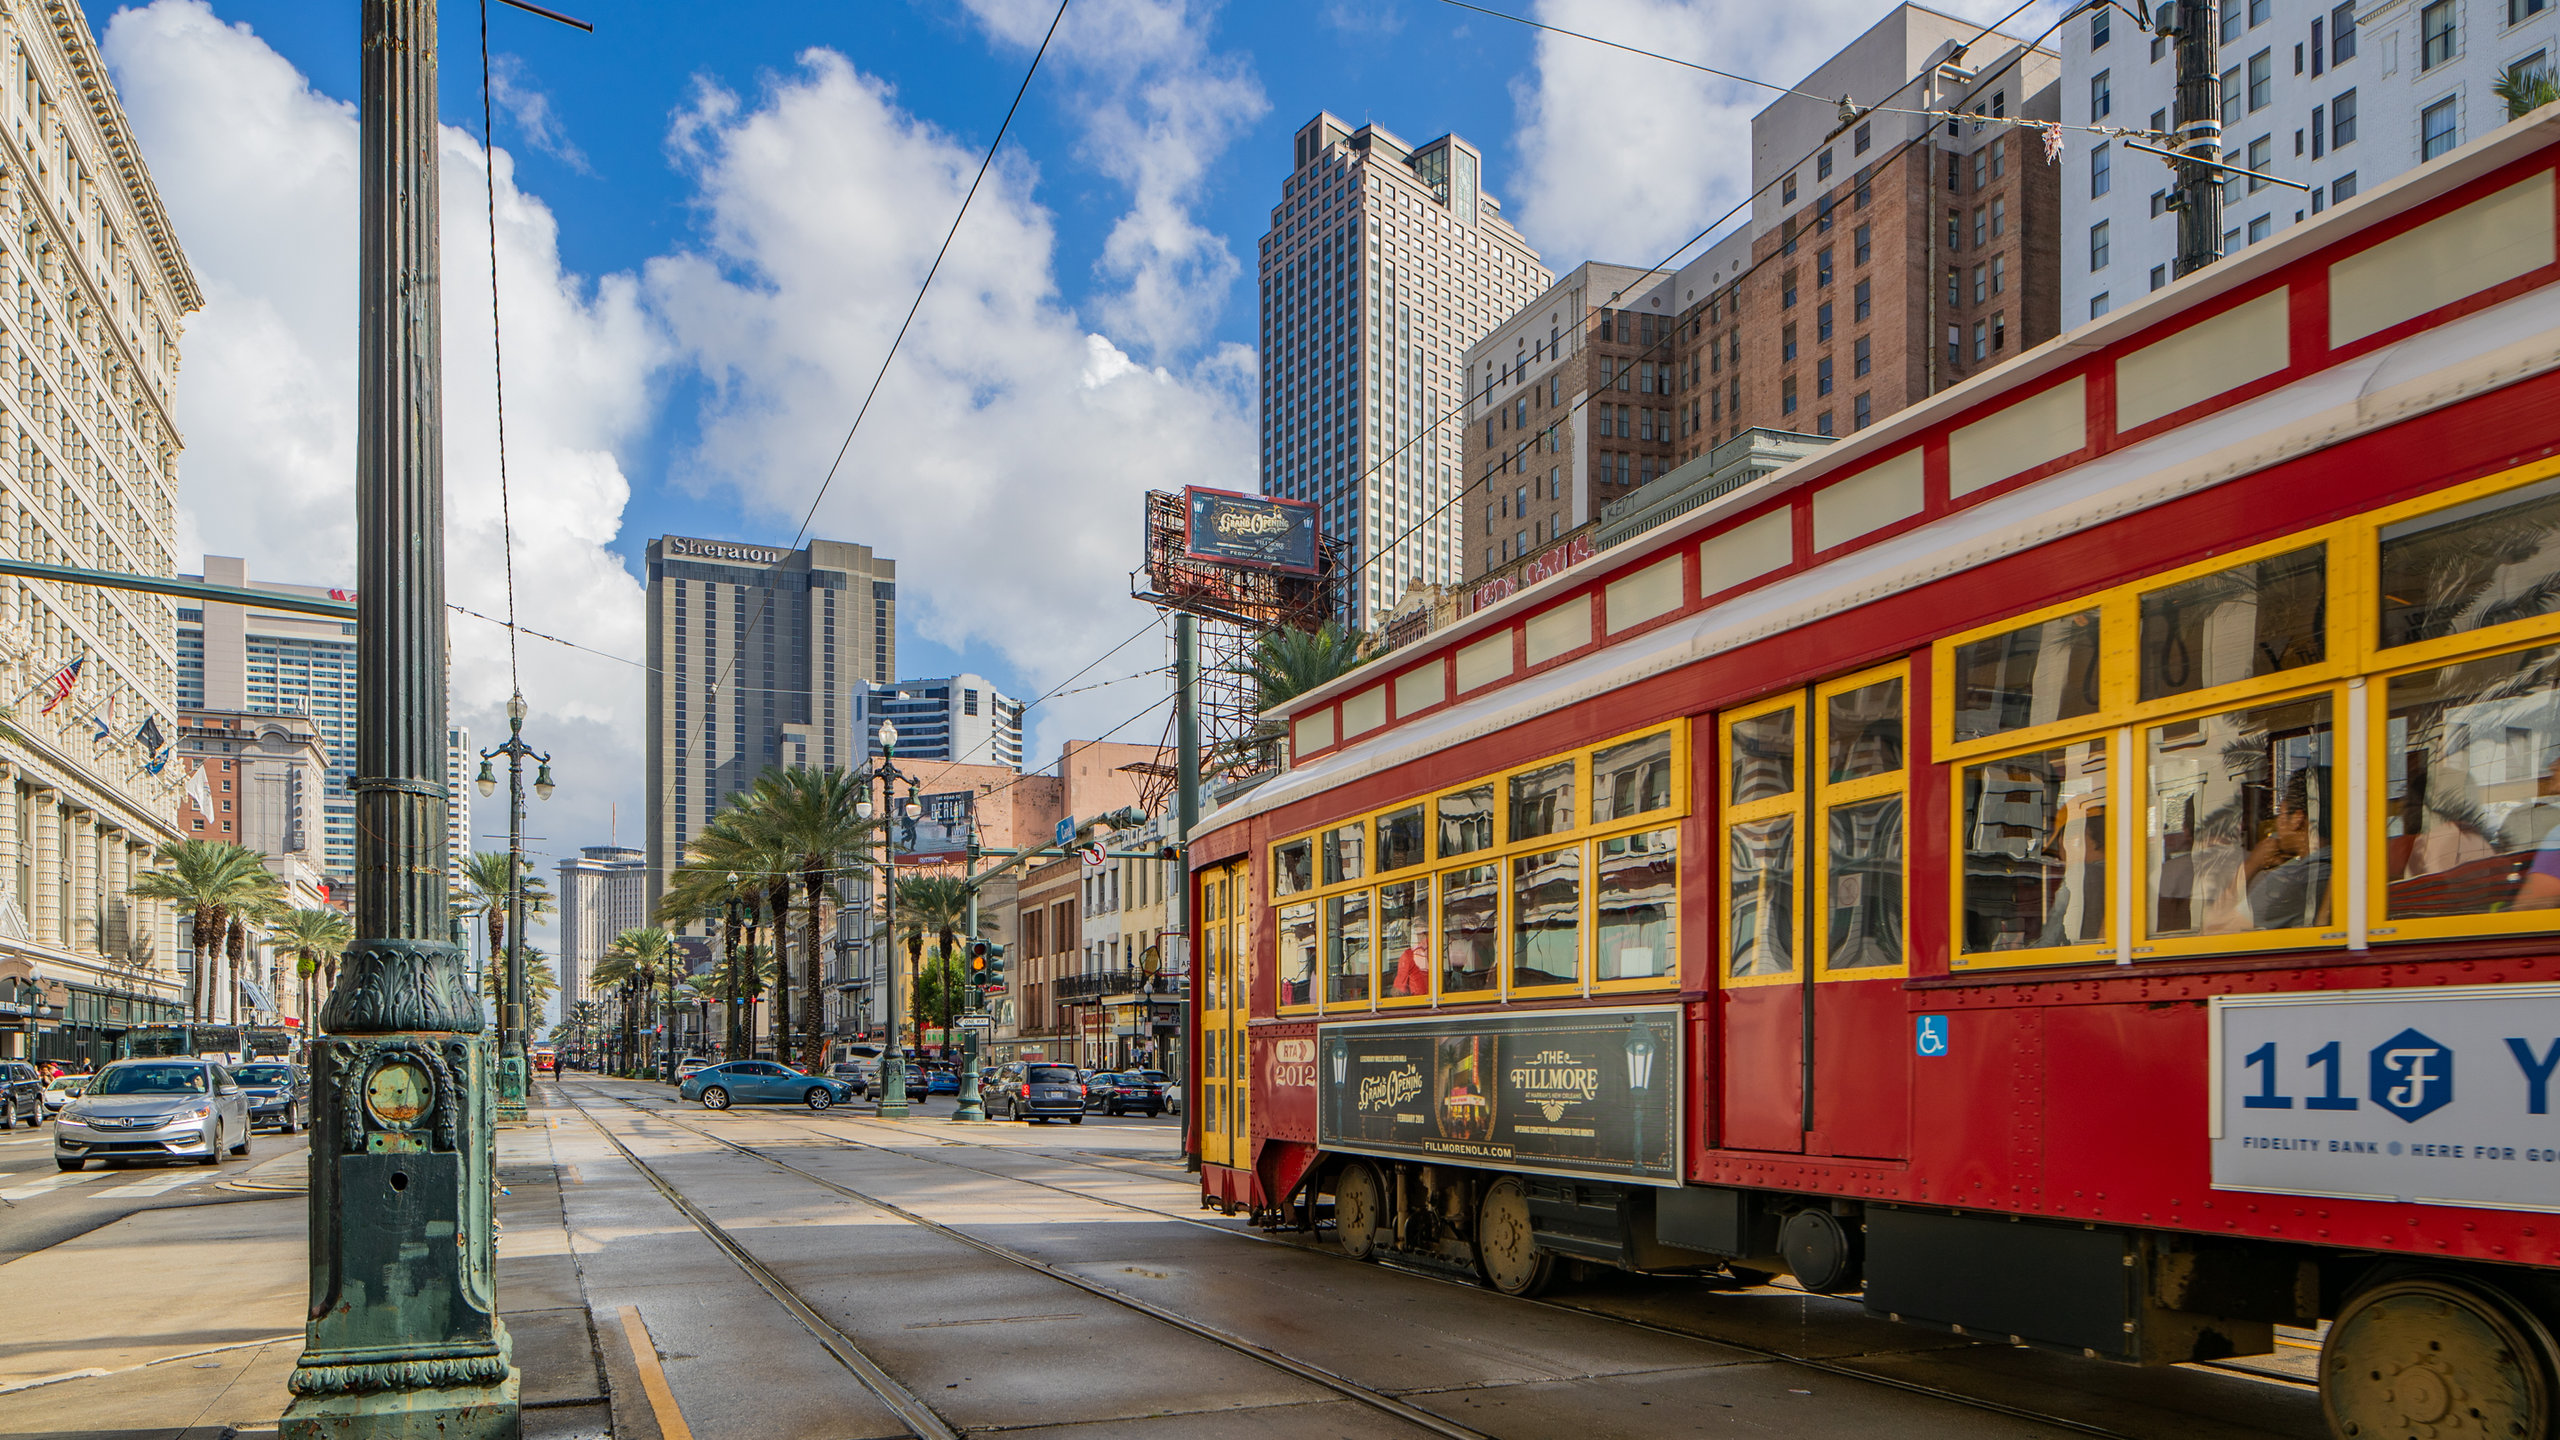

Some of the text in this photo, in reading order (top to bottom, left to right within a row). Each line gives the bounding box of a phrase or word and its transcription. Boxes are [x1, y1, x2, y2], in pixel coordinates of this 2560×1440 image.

[1218, 512, 1289, 535] GRAND OPENING
[674, 537, 777, 562] Sheraton
[294, 769, 303, 830] ASTOR
[931, 801, 965, 820] BERLIN
[1283, 1044, 1298, 1058] RTA
[1541, 1050, 1564, 1065] THE
[1275, 1065, 1316, 1087] 2012
[1510, 1068, 1599, 1101] FILLMORE
[1358, 1064, 1423, 1112] GRAND OPENING
[1425, 1142, 1512, 1158] FILLMORENOLA.COM
[2243, 1136, 2560, 1163] FIDELITY BANK HERE FOR GO
